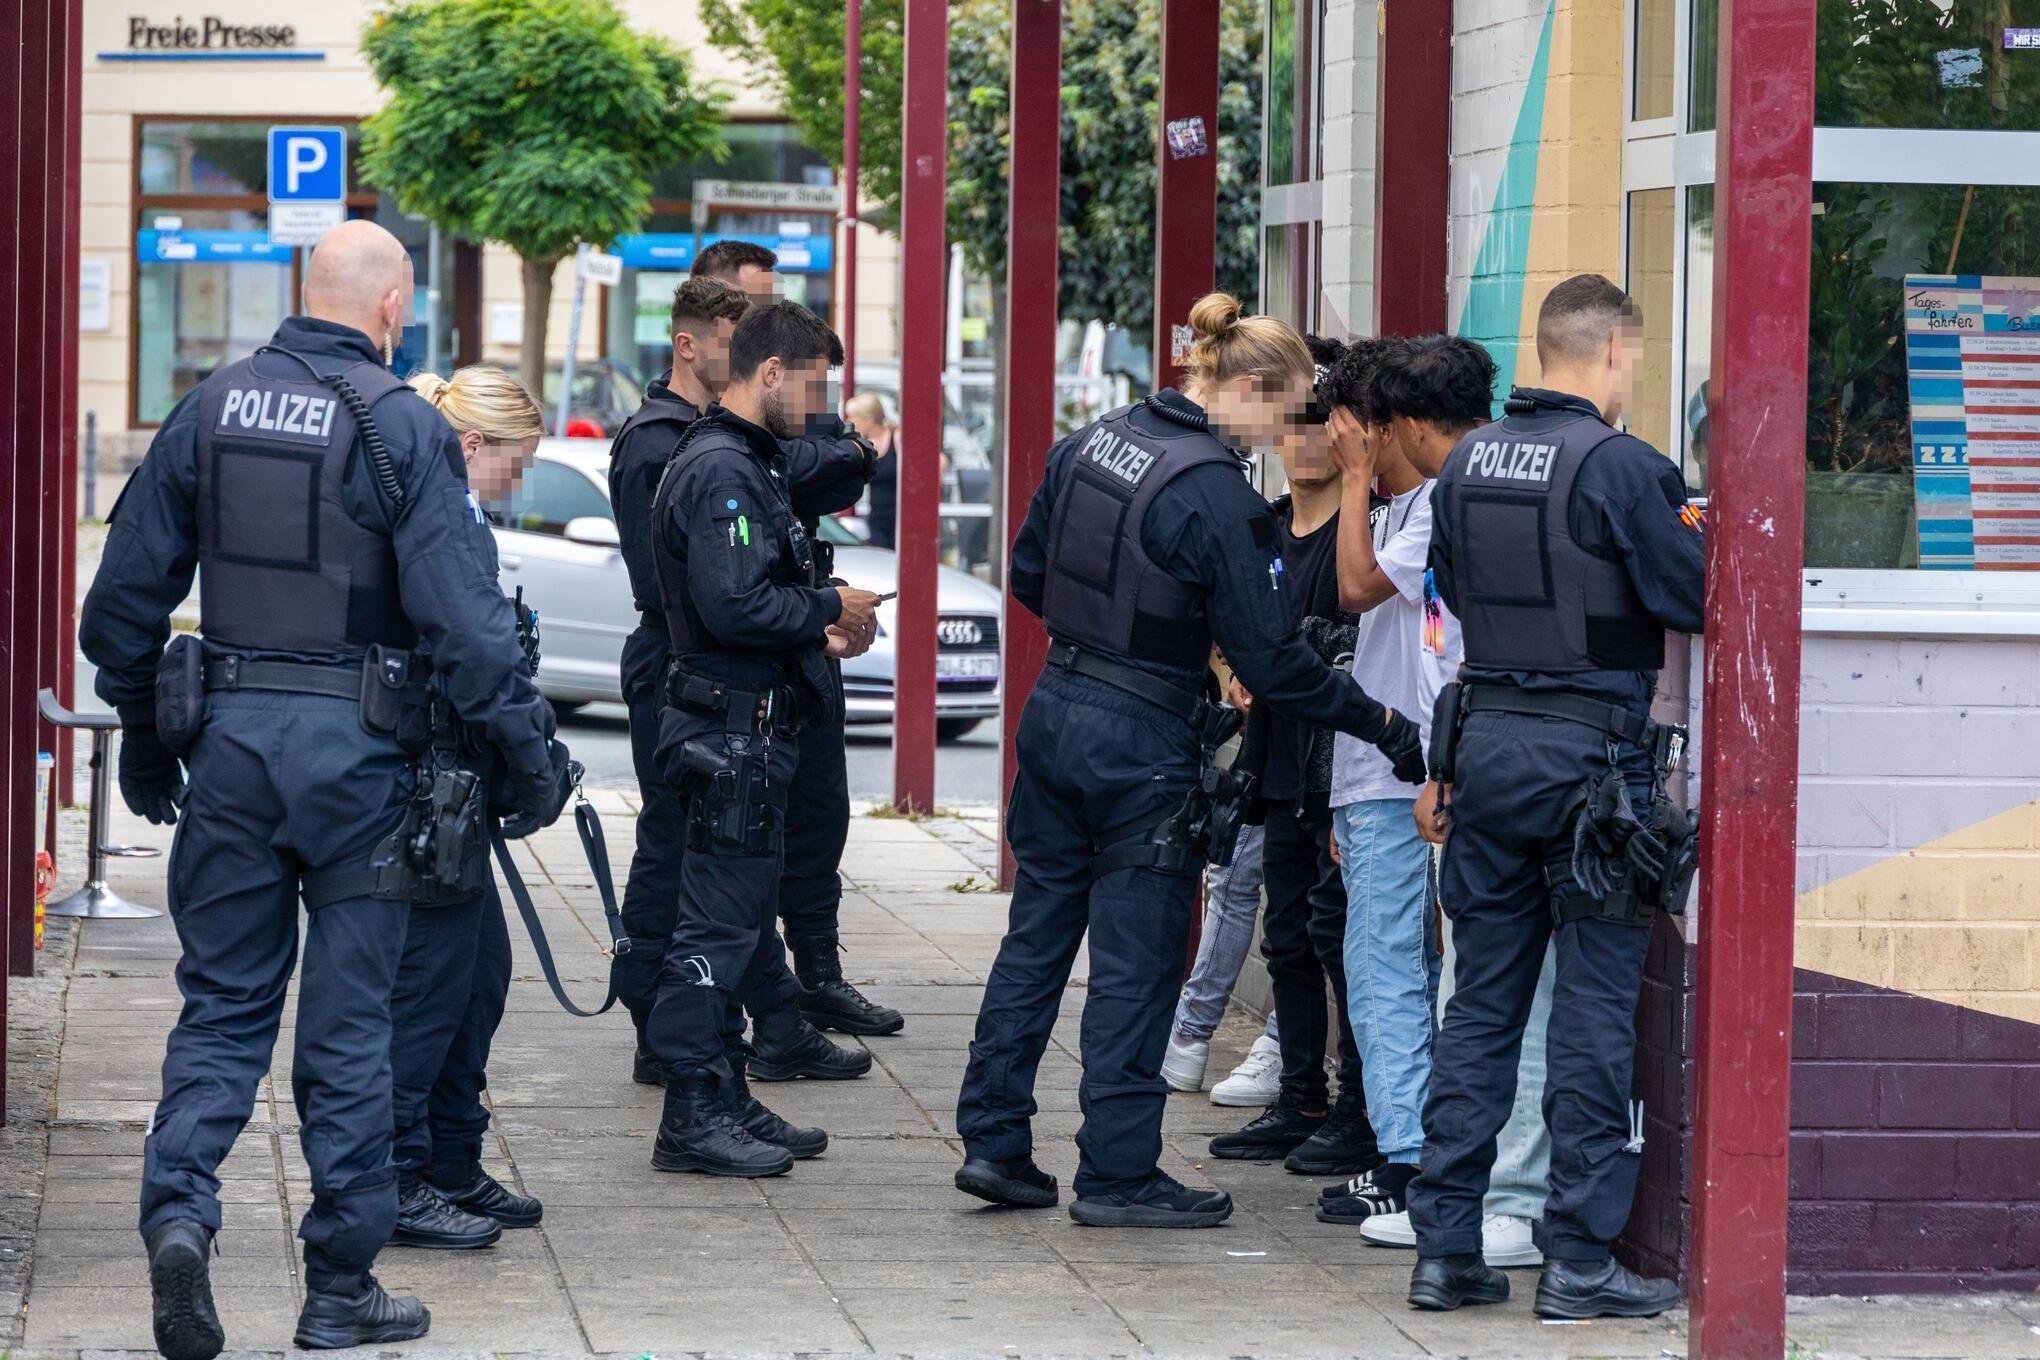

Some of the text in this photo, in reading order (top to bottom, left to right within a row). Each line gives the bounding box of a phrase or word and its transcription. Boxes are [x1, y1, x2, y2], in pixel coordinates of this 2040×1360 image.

[129, 16, 296, 48] Freie Presse
[287, 137, 327, 193] P
[1928, 311, 1973, 331] fahrten
[220, 389, 336, 437] POLIZEI
[1082, 427, 1154, 484] POLIZEI
[1465, 441, 1557, 481] POLIZEI
